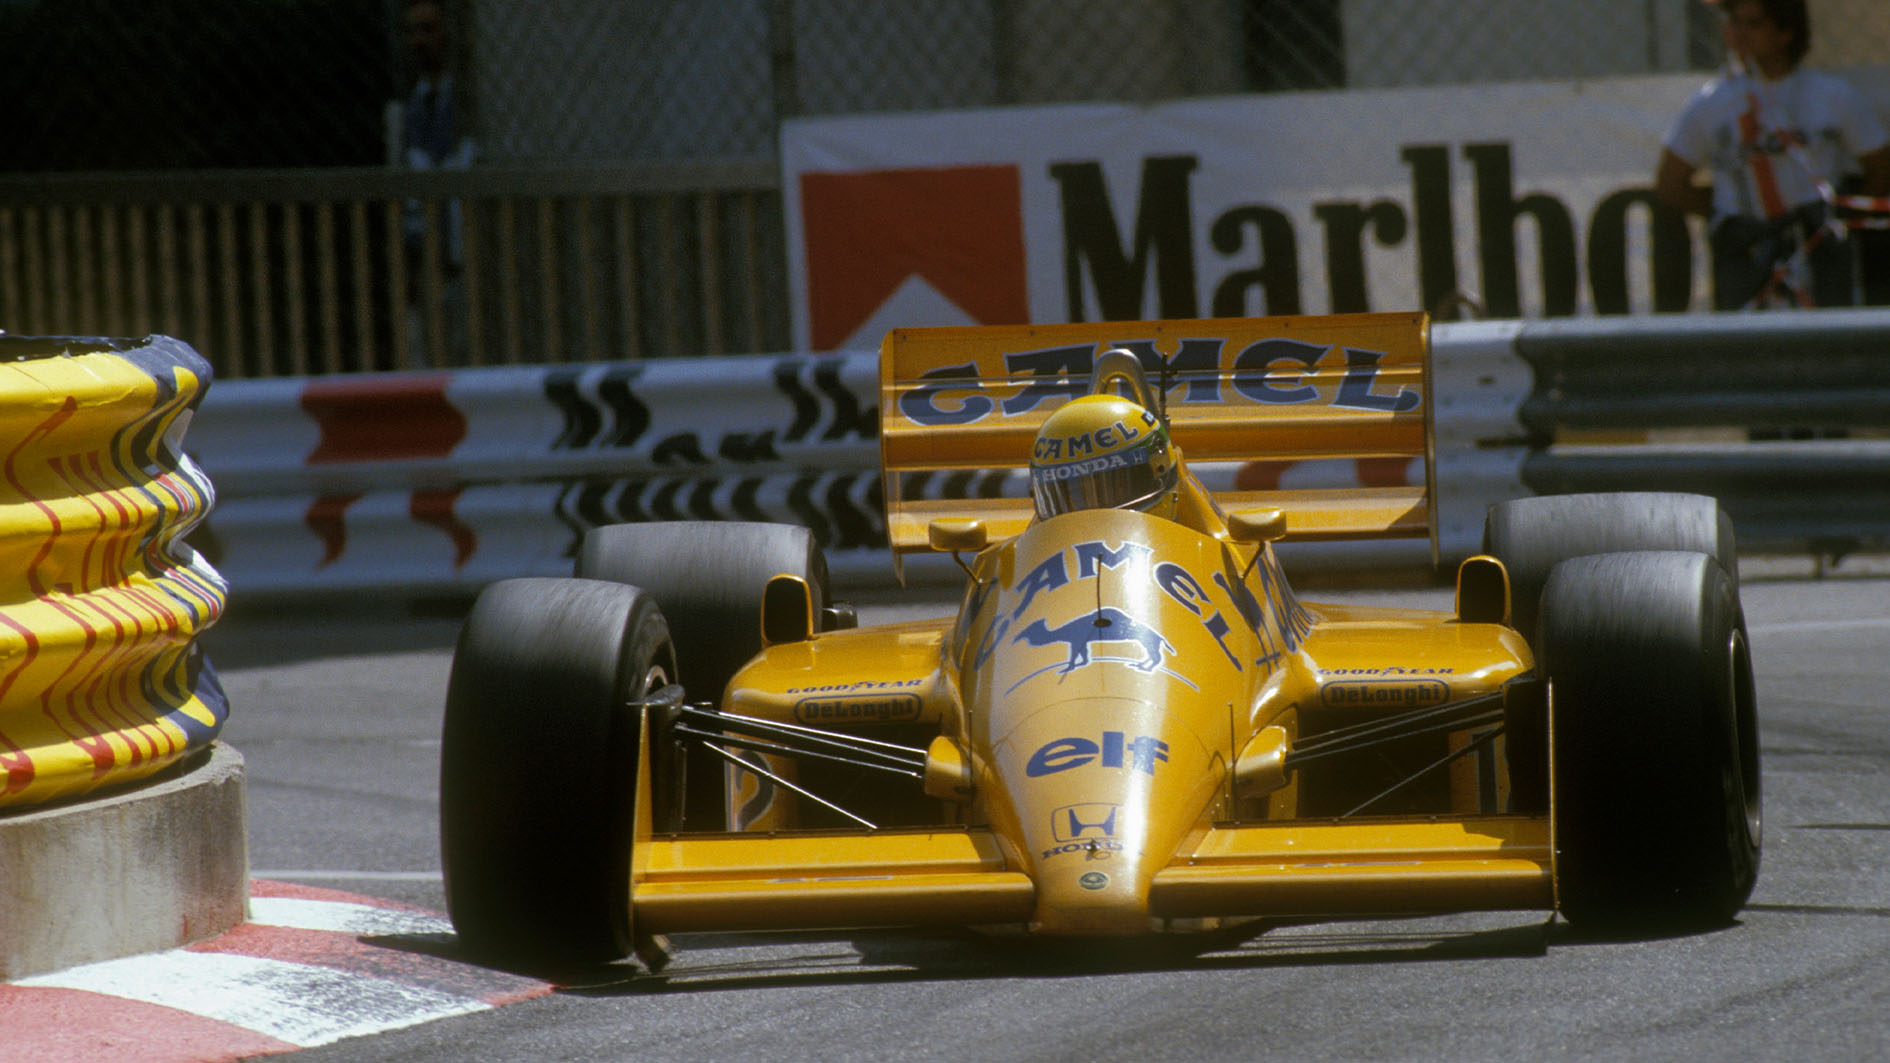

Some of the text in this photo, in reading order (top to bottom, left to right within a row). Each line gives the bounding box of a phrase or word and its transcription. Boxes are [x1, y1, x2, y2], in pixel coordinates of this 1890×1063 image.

[1048, 141, 1694, 322] Marlbo
[899, 337, 1421, 426] CAMEL
[1034, 420, 1139, 461] CAMEL
[1042, 455, 1128, 483] HONDA
[973, 540, 1244, 673] CAMEL
[786, 679, 923, 694] GOODYEAR
[1317, 666, 1455, 677] GOODYEAR
[804, 698, 914, 720] DeLonghi
[1330, 684, 1441, 706] DeLonghi
[1026, 731, 1169, 777] elf
